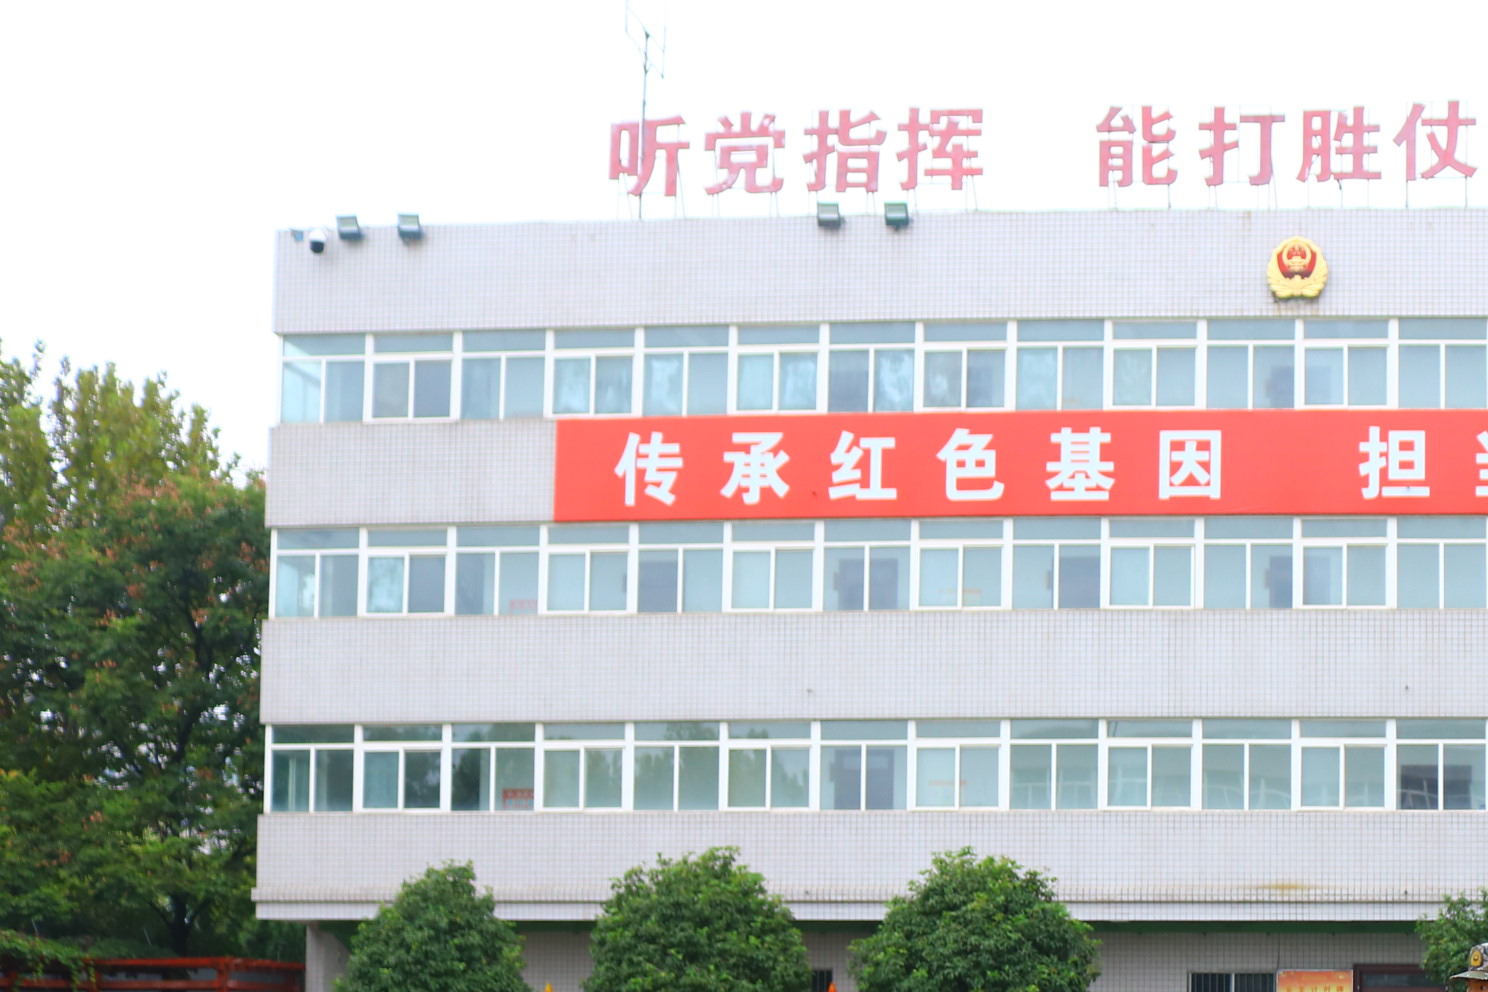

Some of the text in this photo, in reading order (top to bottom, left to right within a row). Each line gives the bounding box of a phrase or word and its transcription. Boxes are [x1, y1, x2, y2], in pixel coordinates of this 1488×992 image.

[609, 107, 983, 197] 听党指挥
[1096, 101, 1476, 187] 能打胜仗
[614, 426, 1223, 506] 传承红色基因
